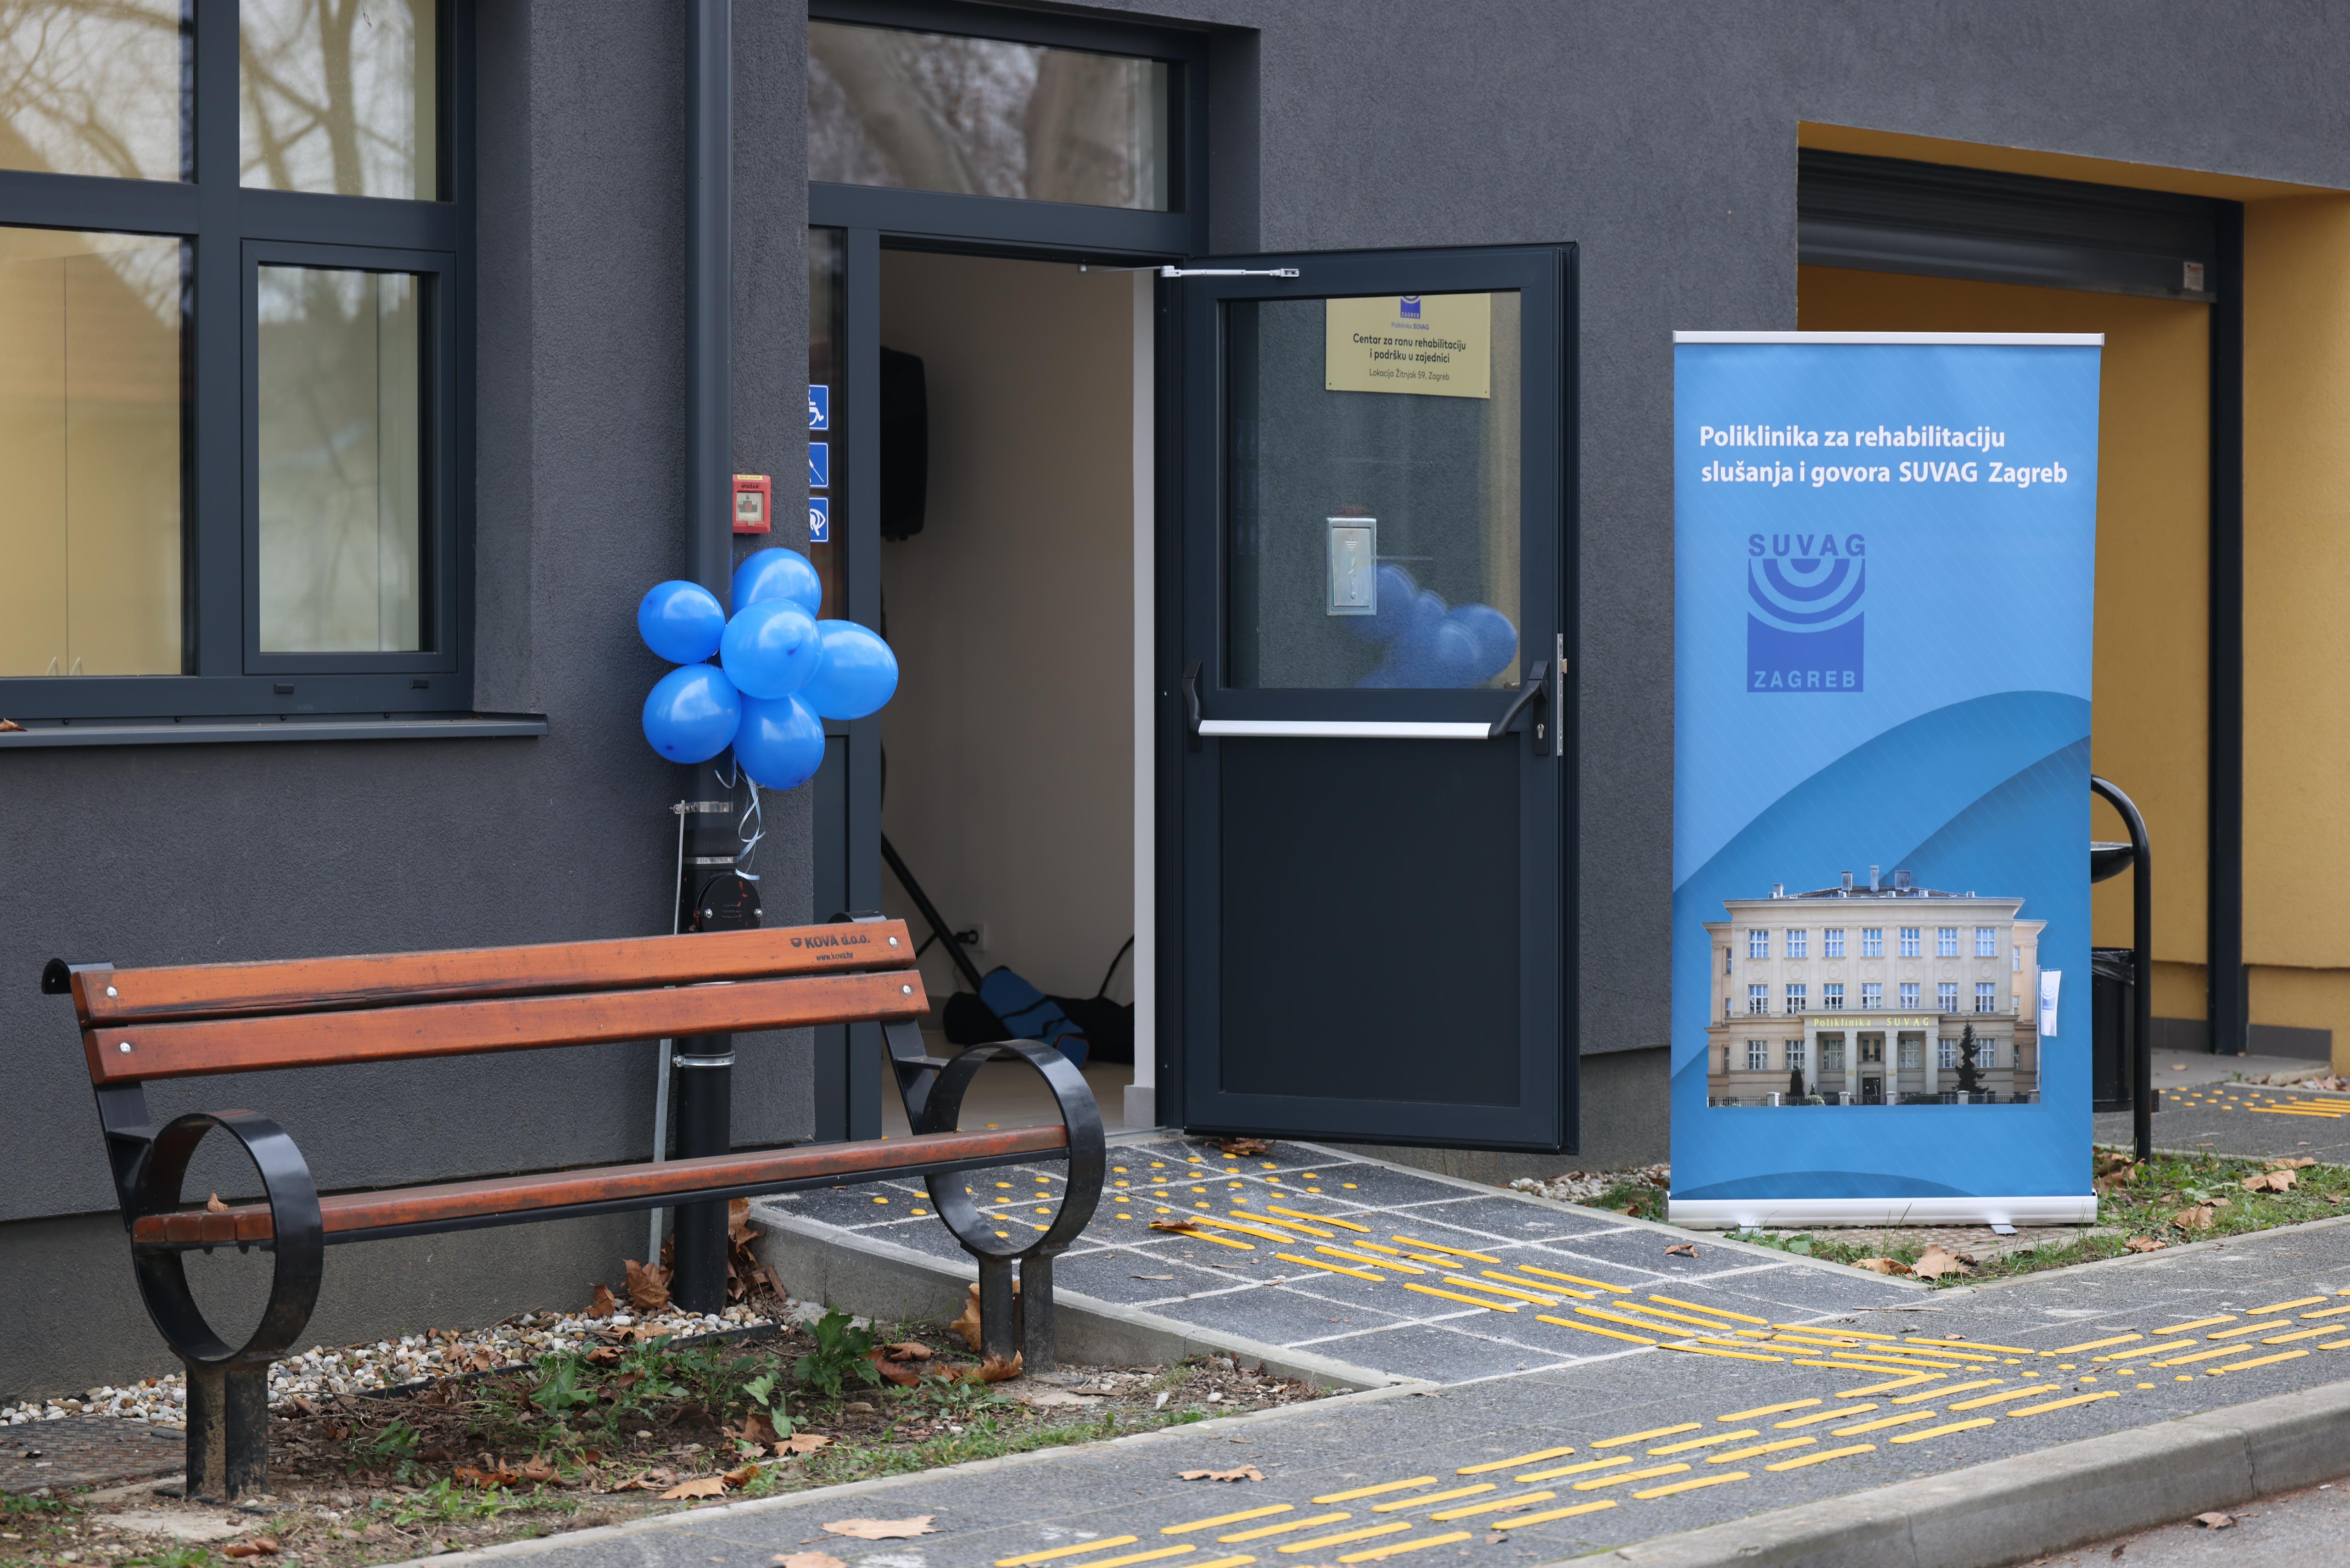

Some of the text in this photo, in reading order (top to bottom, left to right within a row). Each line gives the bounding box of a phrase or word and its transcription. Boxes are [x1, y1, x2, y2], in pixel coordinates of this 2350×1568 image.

[1353, 333, 1382, 345] Centar
[1415, 338, 1466, 352] rehabilitaciju
[1370, 349, 1372, 358] i
[1374, 349, 1406, 362] podršku
[1416, 353, 1450, 364] zajednici
[1369, 368, 1450, 382] Lokacija Žitnjak 59, Zagreb
[1700, 425, 2005, 452] Poliklinika za rehabilitaciju
[1701, 460, 2068, 488] slušanja i govora SUVAG Zagreb
[1748, 533, 1865, 557] SUVAG
[1754, 670, 1856, 688] ZAGREB
[805, 934, 871, 948] KOVA d.o.o.
[816, 951, 854, 962] www.kova.hr
[1813, 1017, 1929, 1027] Poliklinika SUVAG
